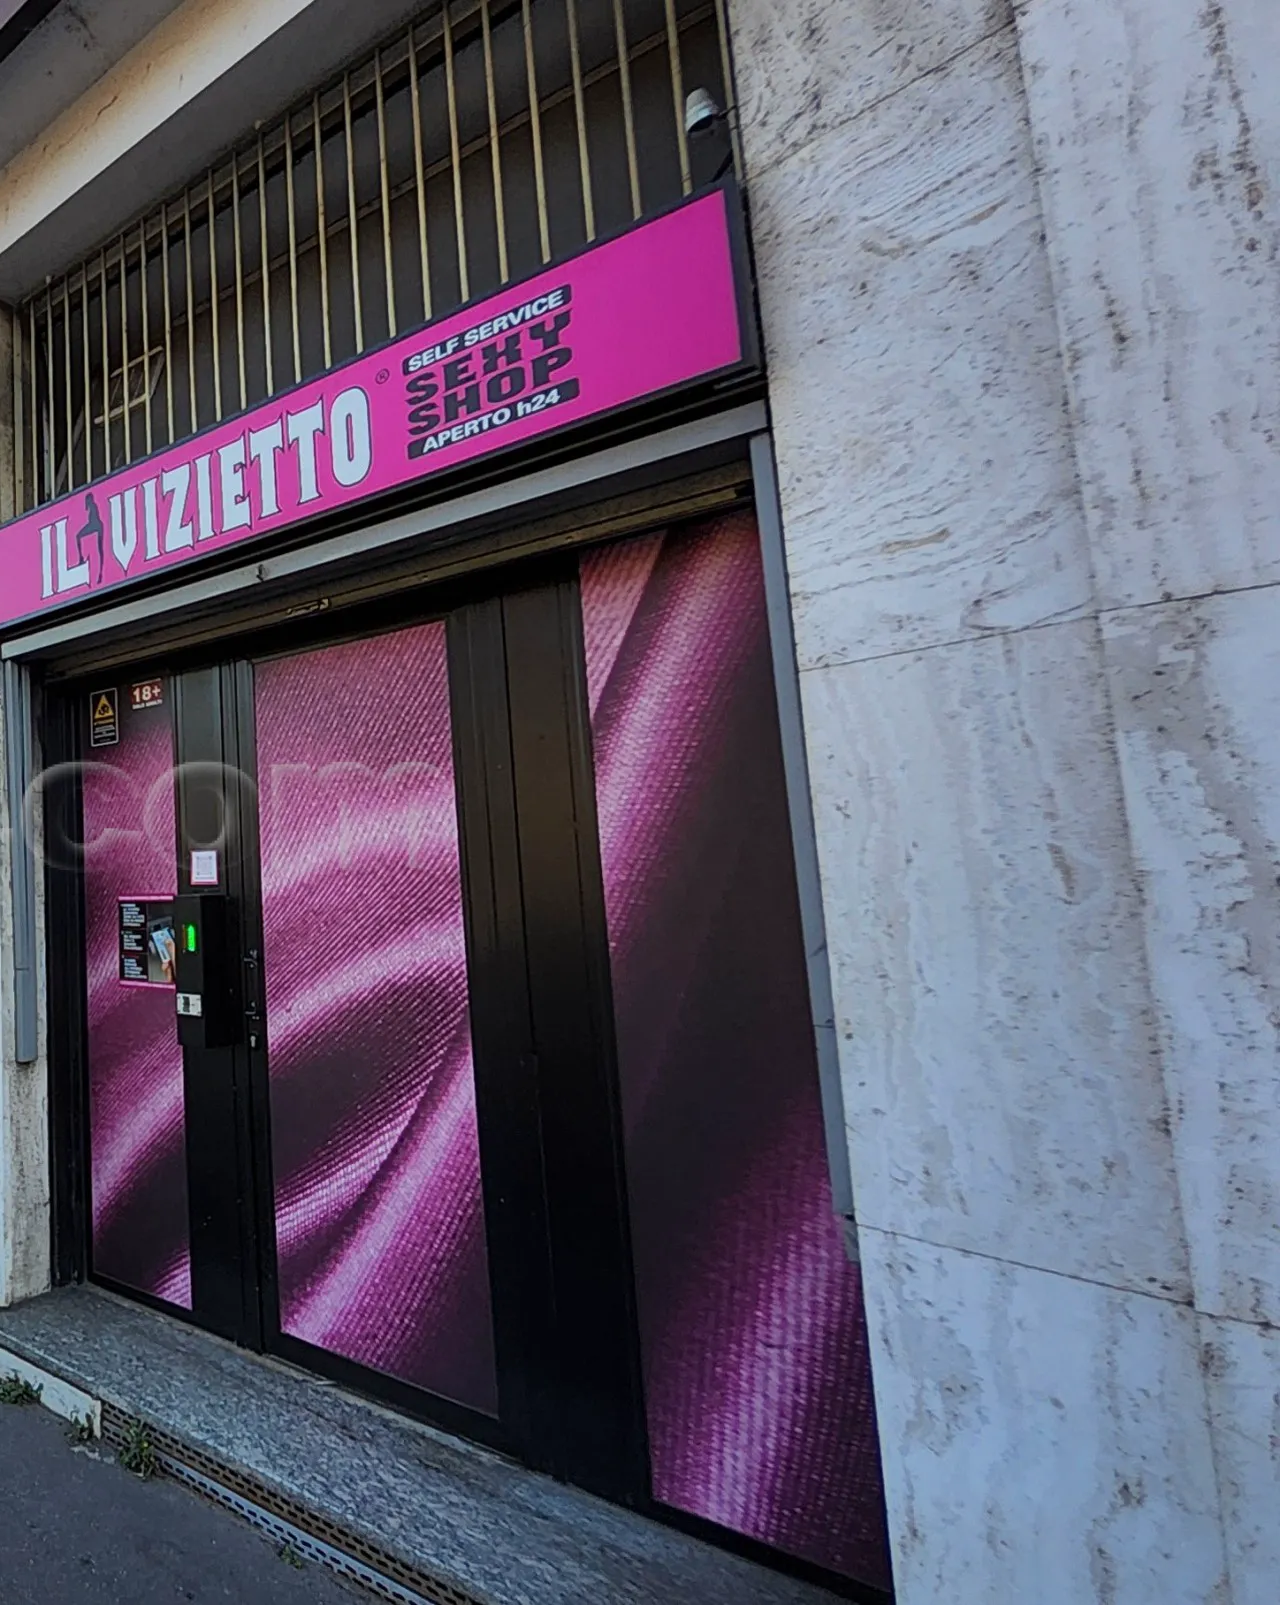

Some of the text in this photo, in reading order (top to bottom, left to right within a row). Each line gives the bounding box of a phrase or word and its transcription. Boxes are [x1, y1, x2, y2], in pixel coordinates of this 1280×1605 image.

[406, 309, 572, 405] SEXY
[408, 289, 564, 372] SELF SERVICE
[407, 347, 573, 436] SHOP
[422, 389, 560, 453] APERTO h24
[39, 386, 373, 600] IL VIZIETTO
[133, 685, 161, 703] 18+
